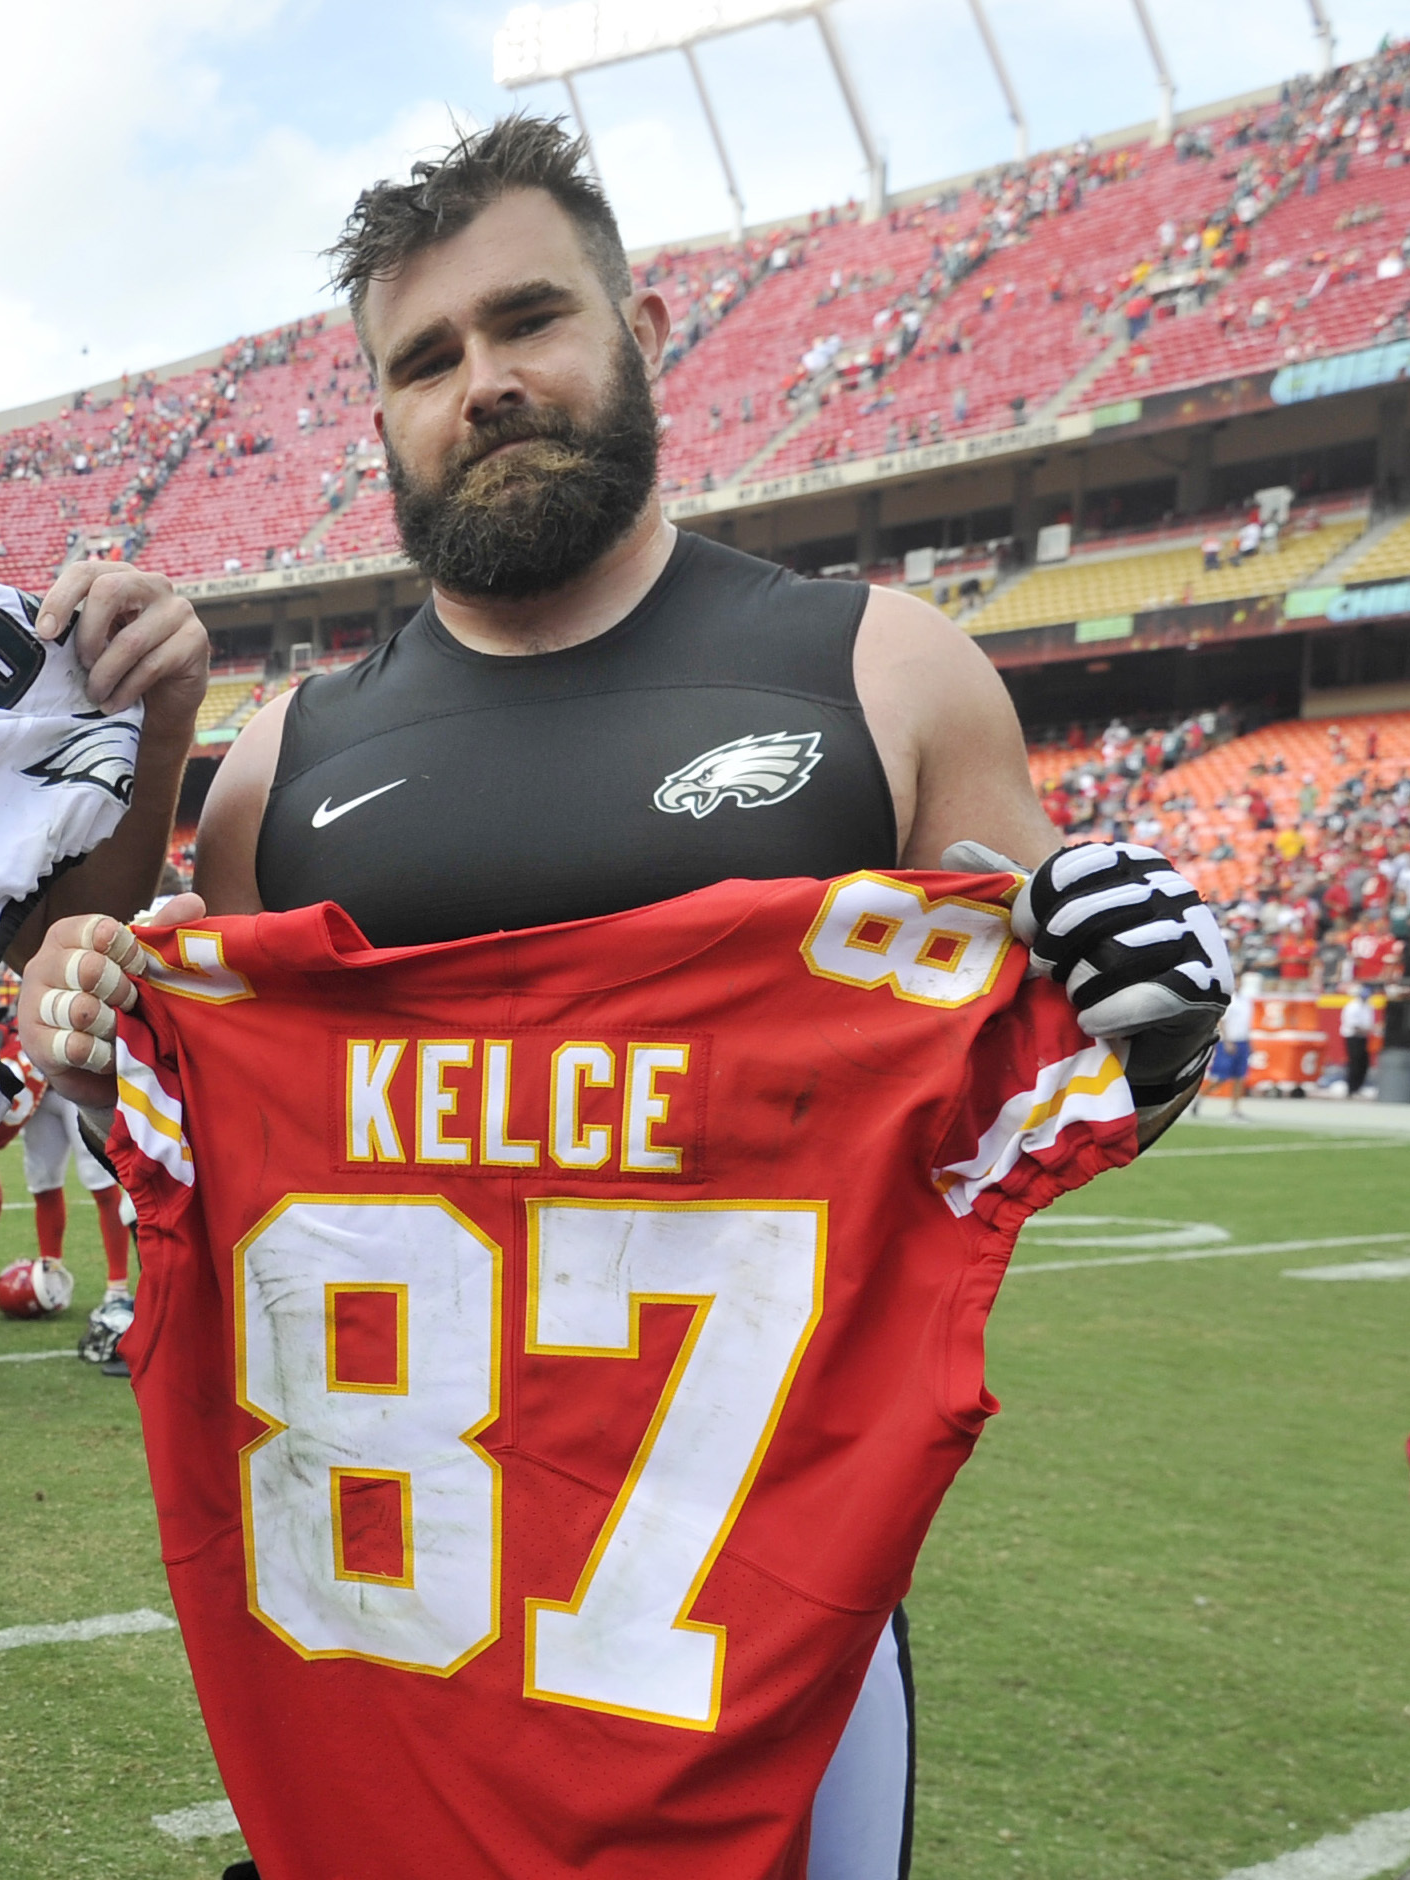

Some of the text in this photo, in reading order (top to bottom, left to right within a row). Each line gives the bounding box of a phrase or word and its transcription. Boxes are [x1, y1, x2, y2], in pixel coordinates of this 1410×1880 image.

[799, 869, 1016, 1009] 8
[346, 1038, 690, 1174] KELCE
[233, 1193, 829, 1732] 87
